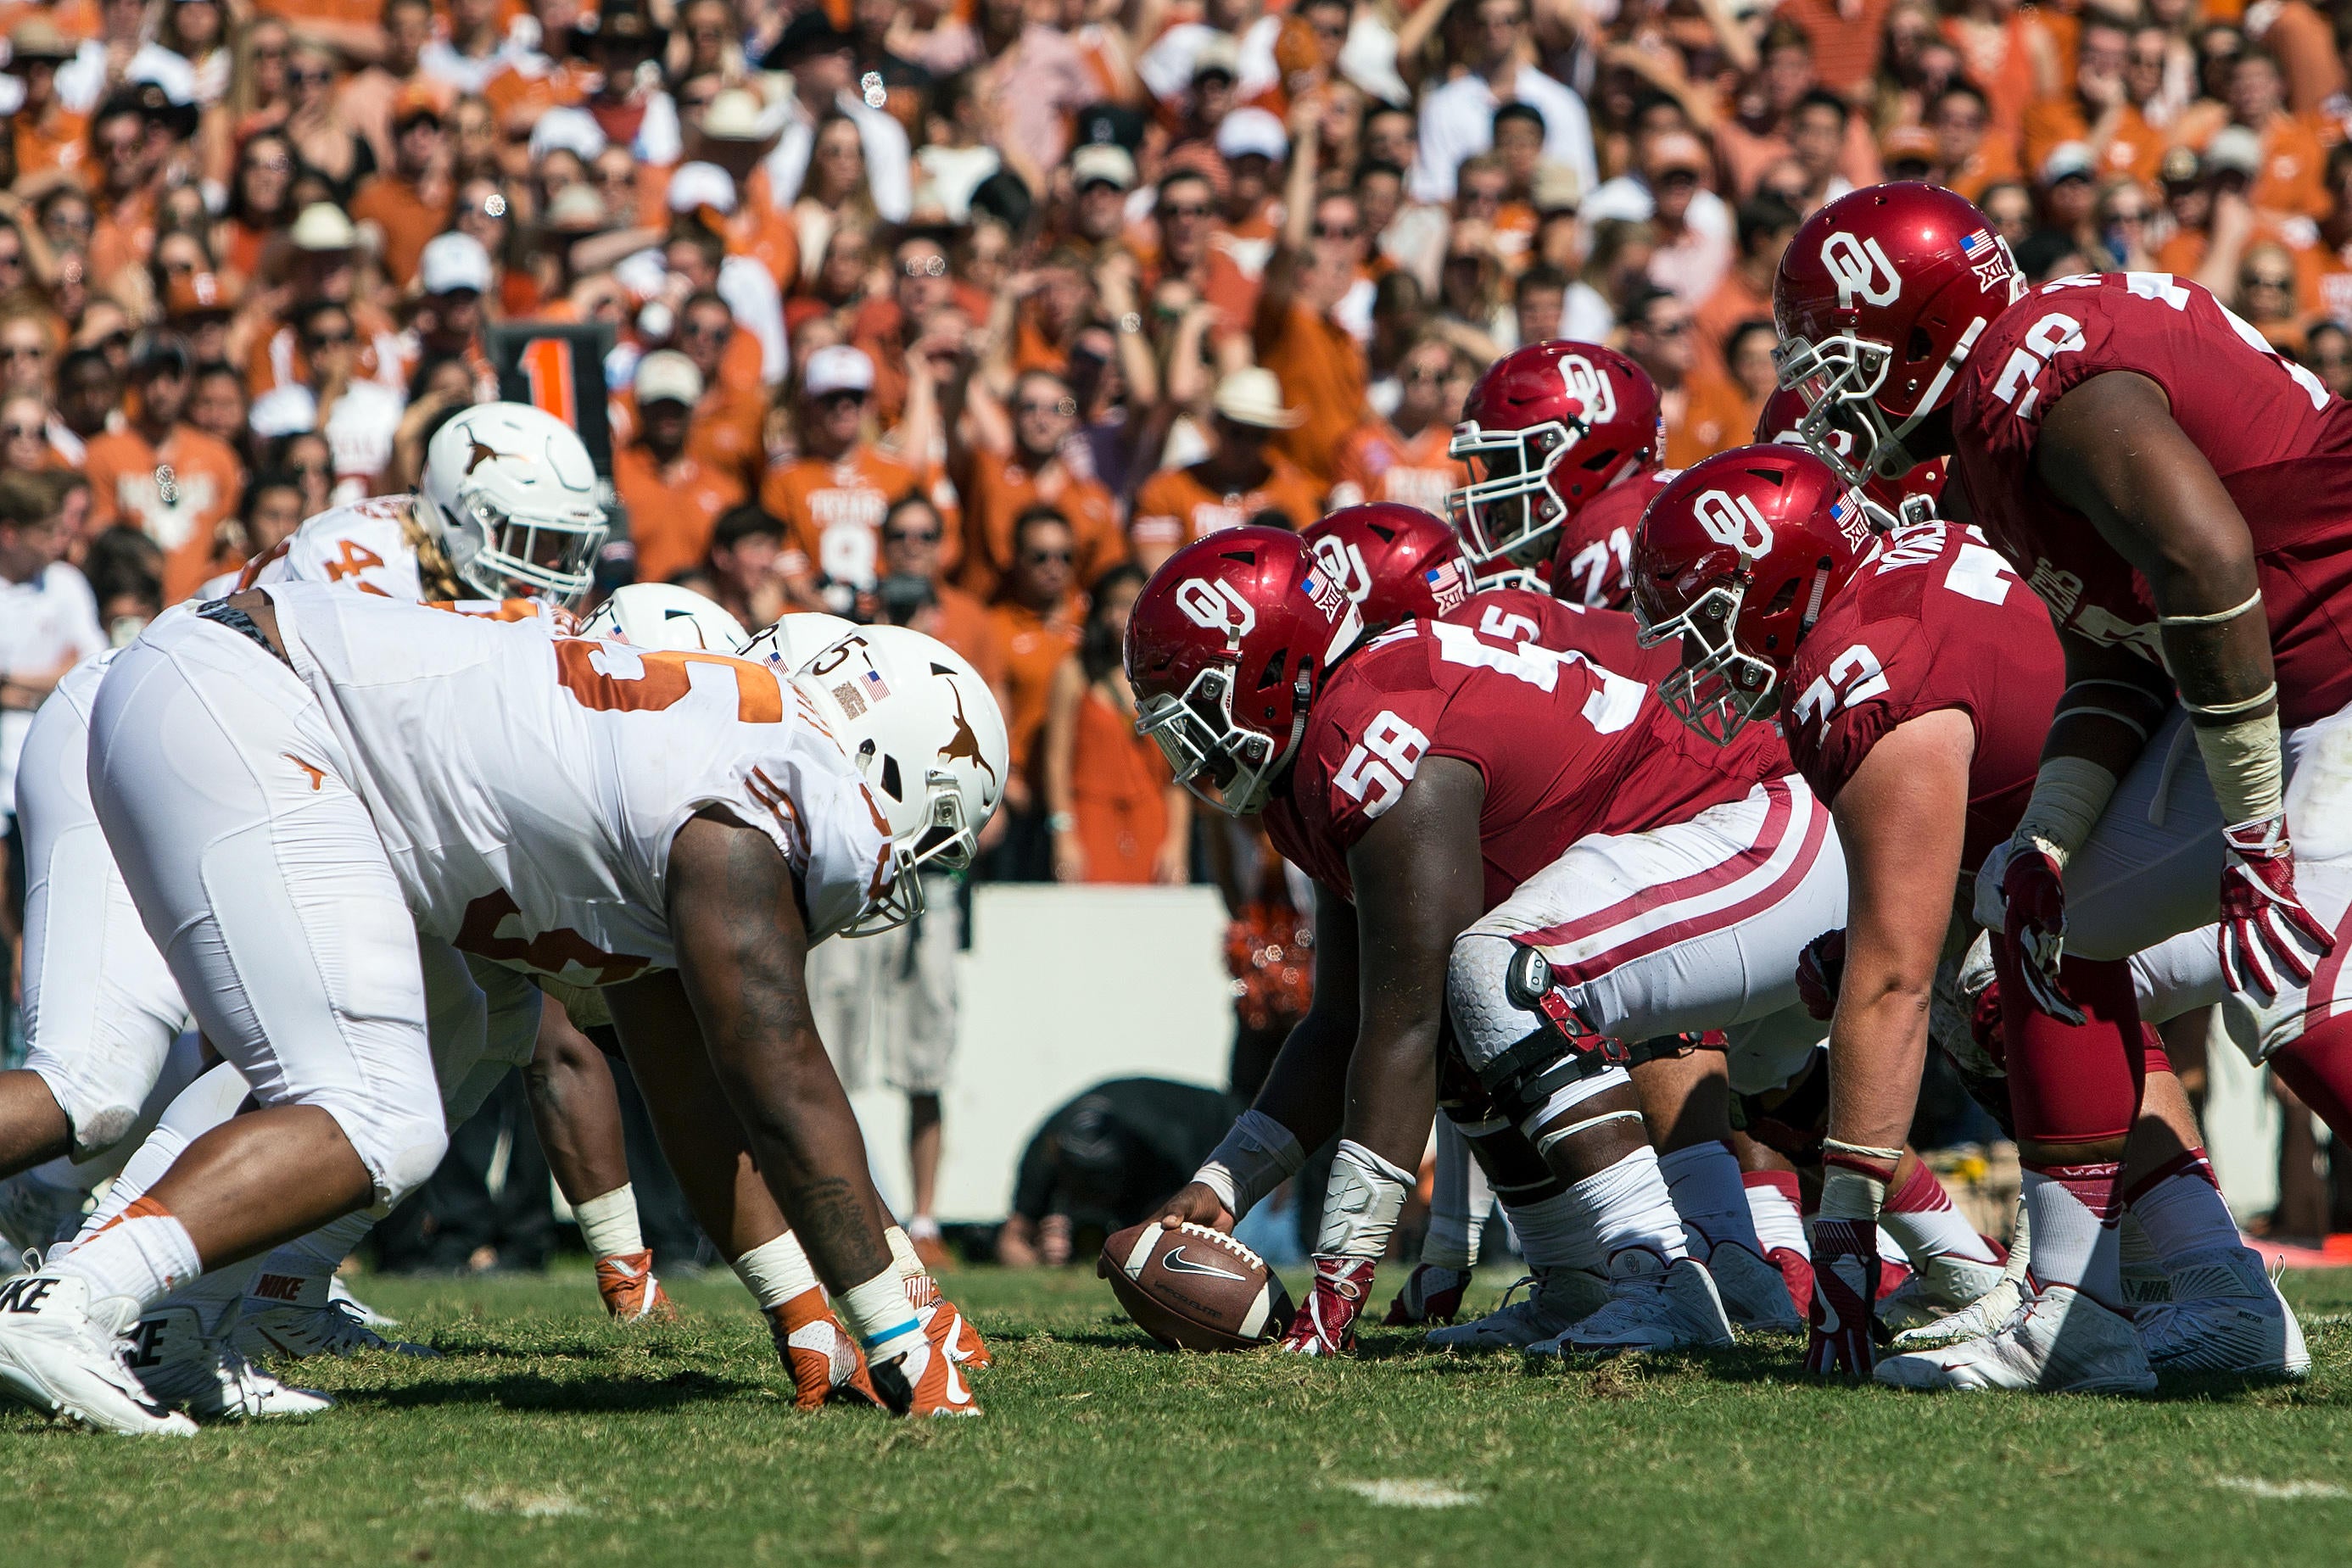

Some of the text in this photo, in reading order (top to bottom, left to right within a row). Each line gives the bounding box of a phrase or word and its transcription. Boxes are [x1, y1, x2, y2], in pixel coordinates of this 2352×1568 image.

[1821, 232, 1902, 307] OU
[517, 338, 578, 431] 1
[1558, 354, 1617, 423] OU
[1694, 489, 1774, 561] OU
[324, 539, 394, 598] 4
[1176, 578, 1255, 636] OU
[1791, 644, 1891, 750] 72
[1332, 710, 1431, 819] 58
[254, 1274, 305, 1300] NIKE
[2136, 1281, 2174, 1303] NIK
